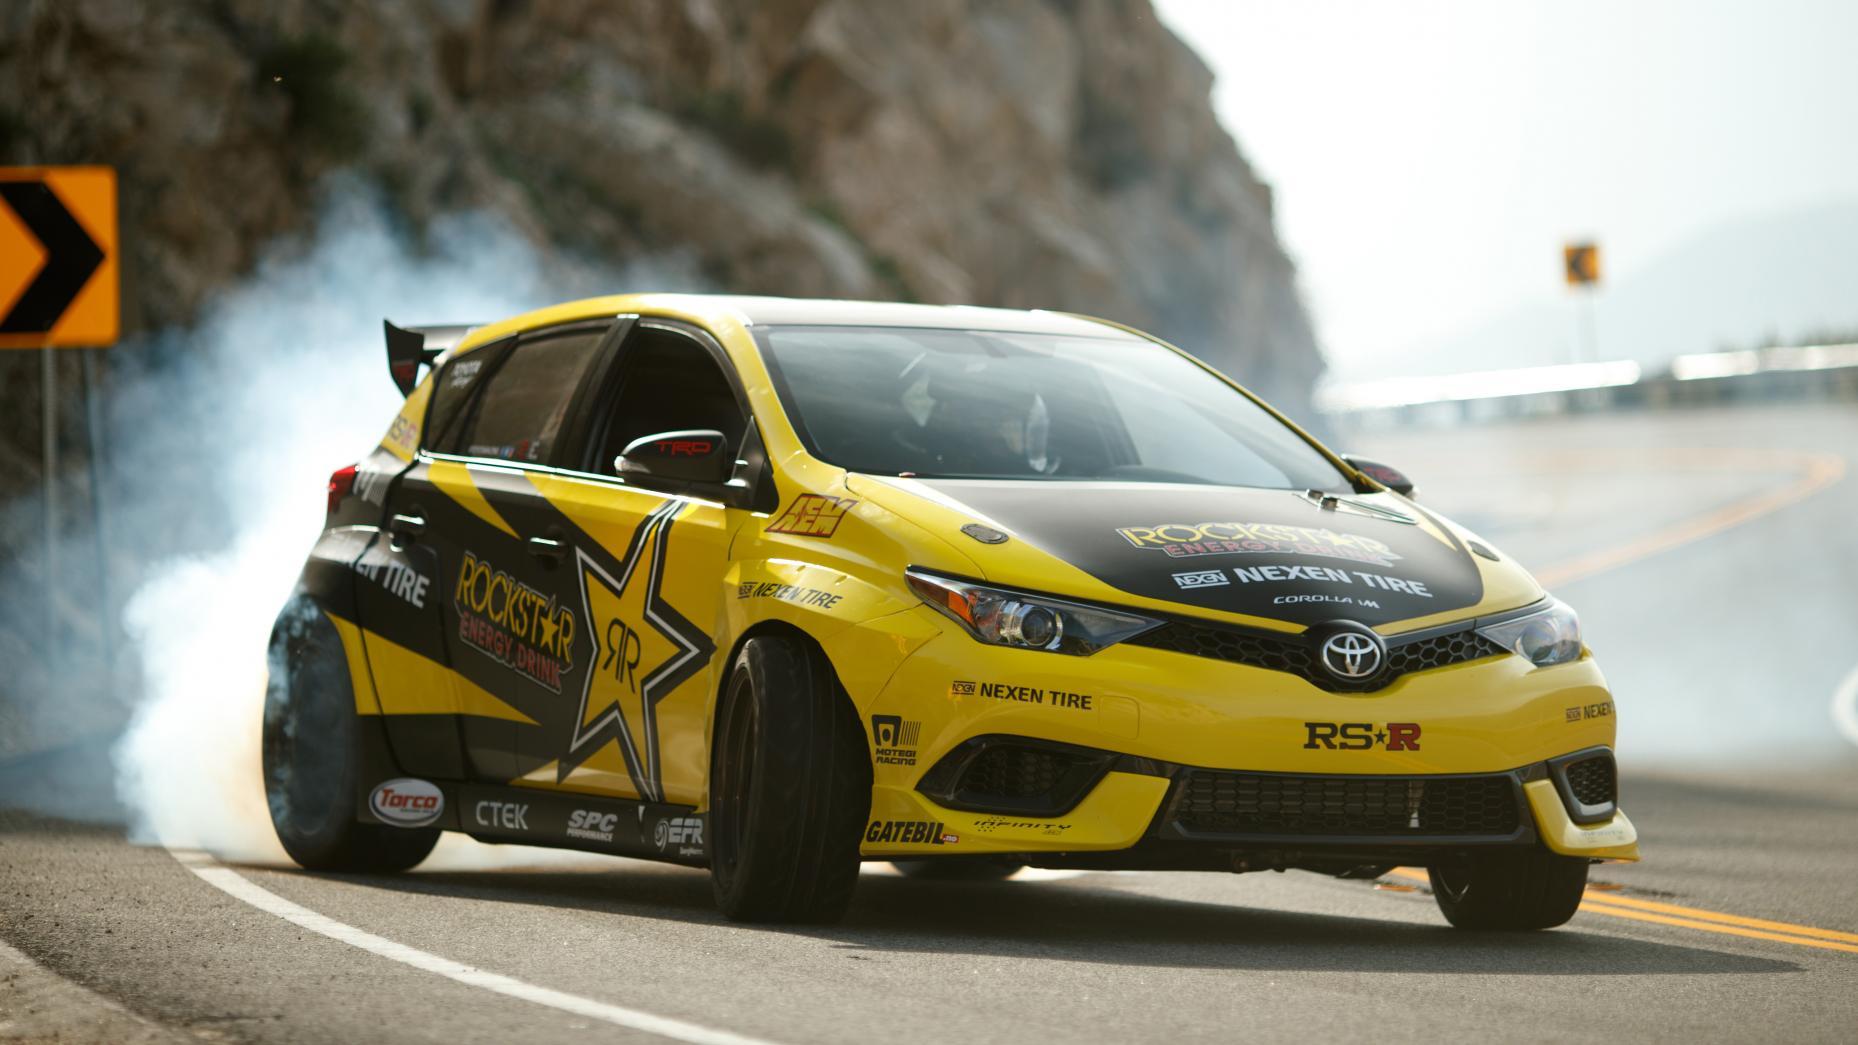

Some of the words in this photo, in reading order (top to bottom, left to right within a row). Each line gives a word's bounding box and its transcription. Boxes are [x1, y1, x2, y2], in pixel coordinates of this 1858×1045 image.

[655, 440, 712, 456] TRD
[382, 560, 430, 609] TIRE
[1233, 565, 1352, 584] NEXEN
[1353, 571, 1434, 598] TIRE
[753, 582, 802, 600] NEXEN
[799, 589, 844, 609] TIRE
[1273, 594, 1353, 605] COROLLA
[459, 610, 514, 661] ENERGY
[516, 644, 562, 691] DRINK
[980, 682, 1044, 704] NEXEN
[1048, 690, 1093, 710] TIRE
[875, 748, 917, 757] MOTEGI
[875, 756, 917, 766] RACING
[381, 788, 438, 809] Torco
[475, 801, 529, 830] CTEK
[567, 809, 618, 833] SPC
[668, 817, 704, 845] EFR
